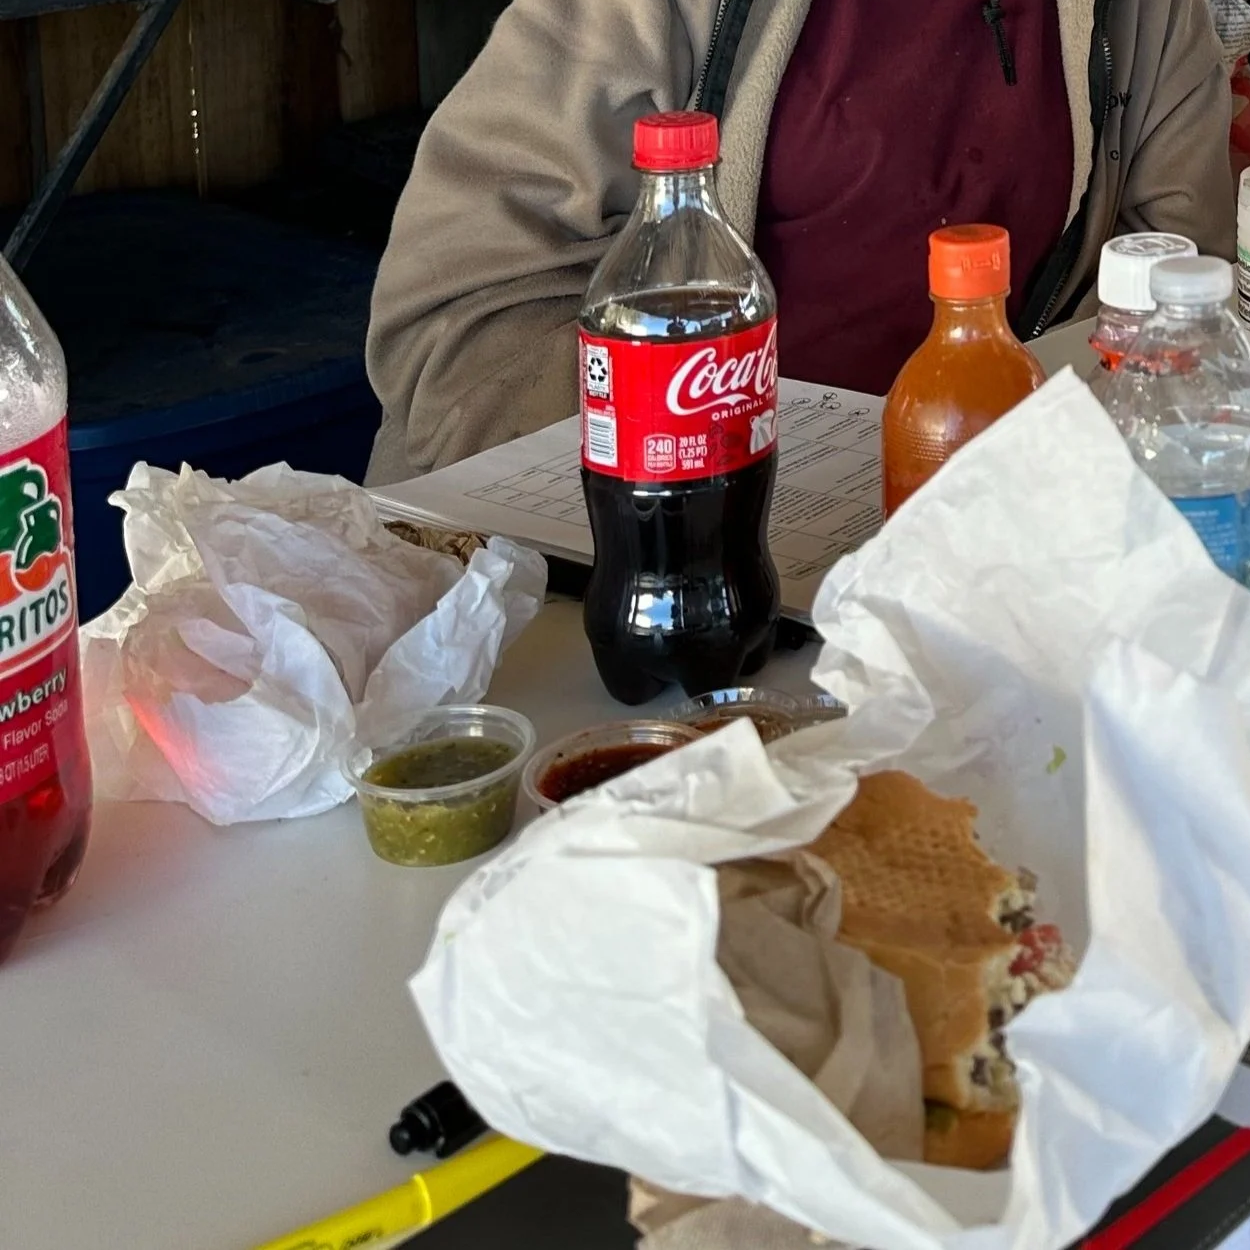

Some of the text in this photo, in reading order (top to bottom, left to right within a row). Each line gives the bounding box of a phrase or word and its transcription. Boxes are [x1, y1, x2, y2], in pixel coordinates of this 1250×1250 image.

[666, 321, 778, 415] Coca-Co
[711, 399, 763, 421] ORIGINAL
[647, 439, 673, 454] 240
[697, 433, 707, 445] OZ
[0, 579, 69, 652] RITOS
[0, 667, 67, 723] wberry
[4, 718, 42, 751] Flavor
